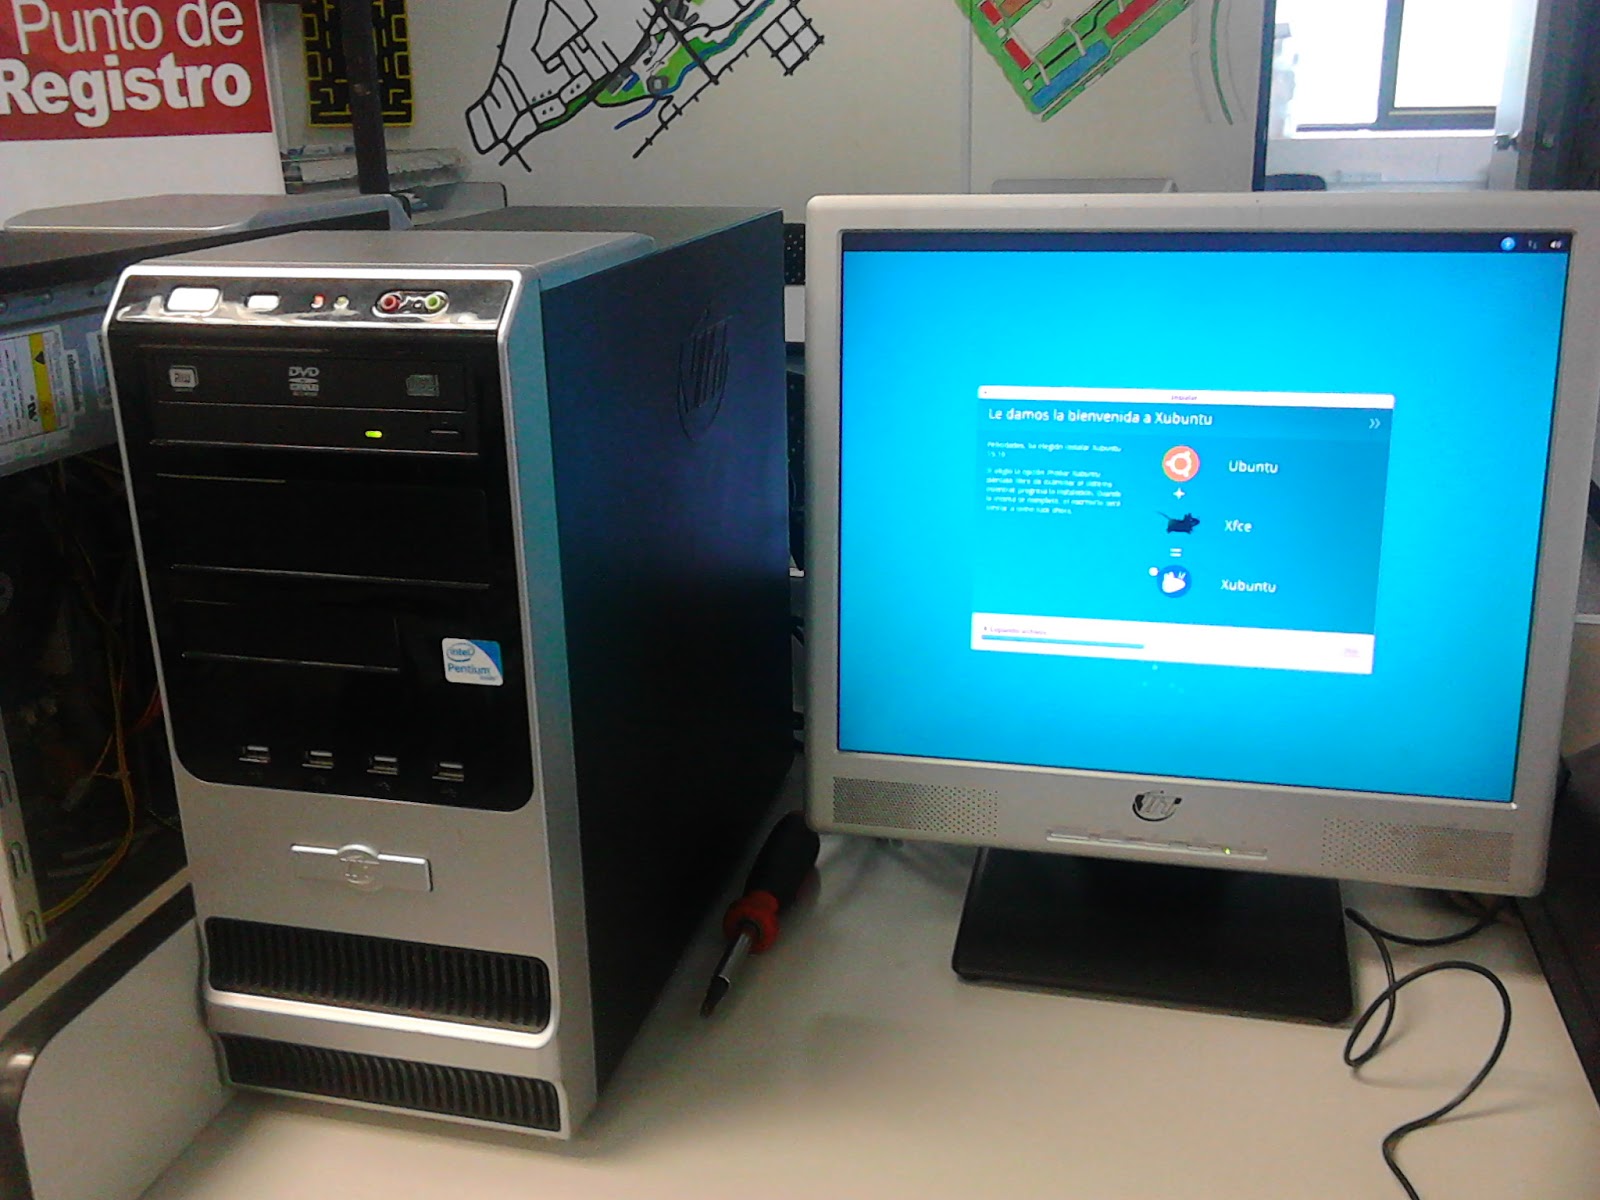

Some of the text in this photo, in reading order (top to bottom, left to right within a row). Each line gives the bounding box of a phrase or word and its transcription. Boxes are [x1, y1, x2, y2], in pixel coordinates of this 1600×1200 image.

[11, 0, 244, 54] Punto de
[0, 52, 252, 128] Registro
[288, 366, 320, 377] DVD
[988, 408, 1213, 426] Le damos la bienvenida a Xubuntu
[1228, 460, 1279, 474] Ubuntu
[1224, 519, 1253, 533] Xfce
[1220, 579, 1277, 593] Xubuntu
[447, 662, 491, 675] Pentium
